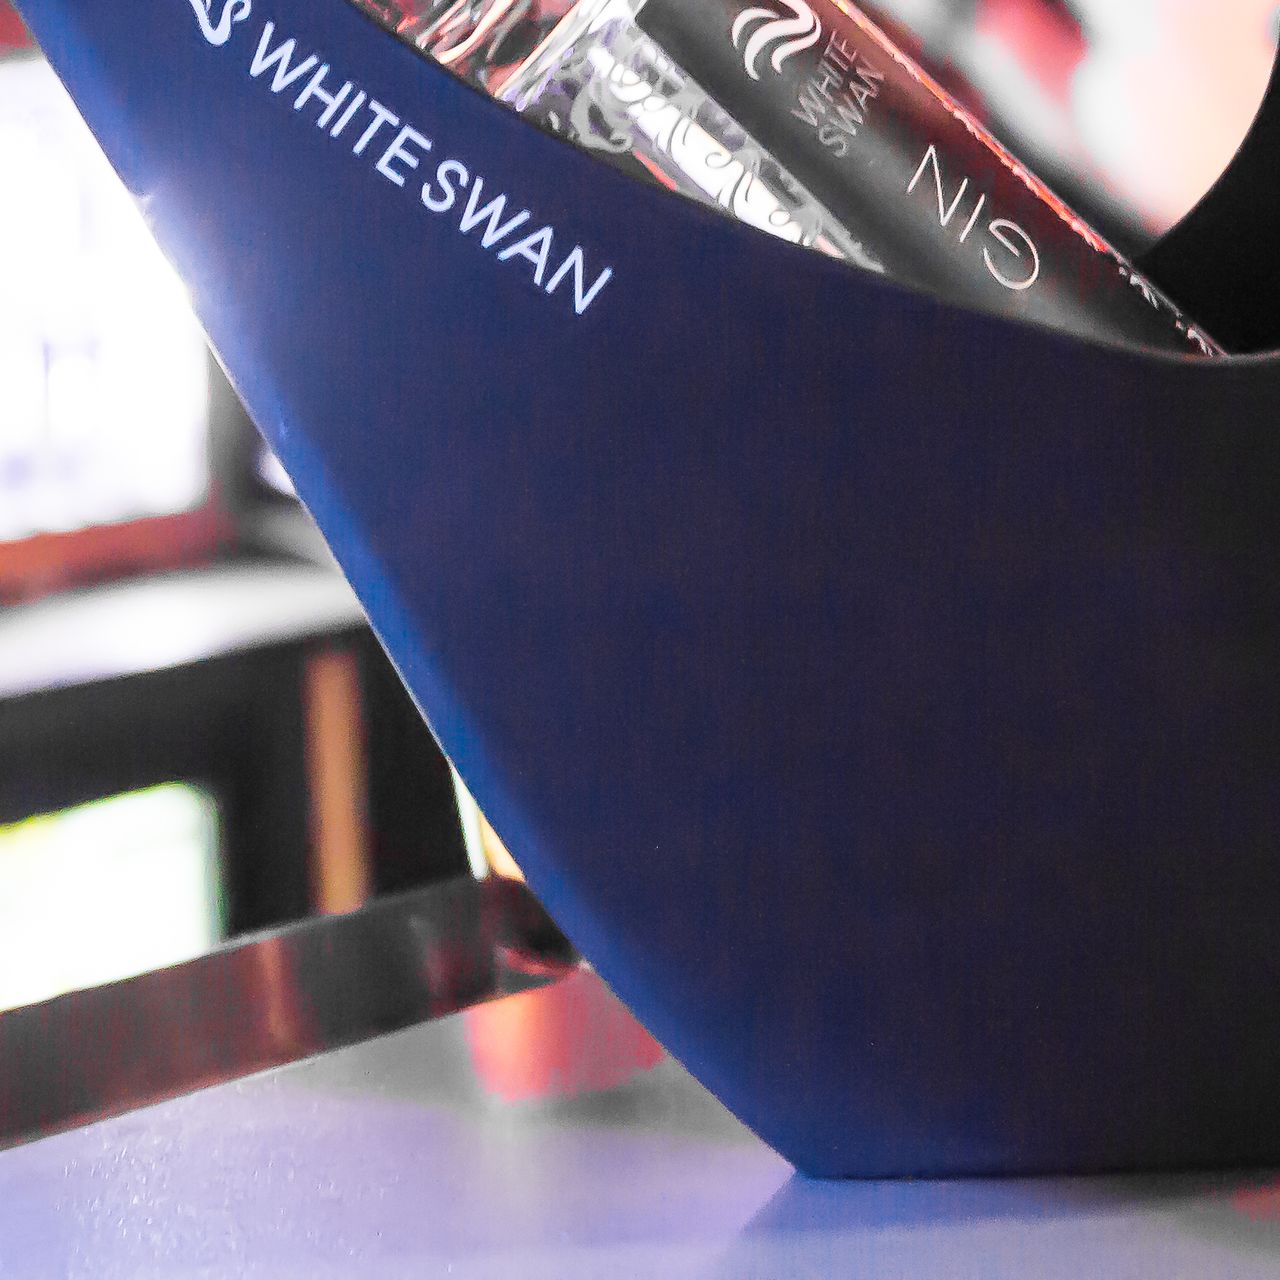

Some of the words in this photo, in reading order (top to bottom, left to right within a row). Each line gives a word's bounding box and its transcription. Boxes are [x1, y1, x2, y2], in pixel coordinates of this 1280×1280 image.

[790, 30, 858, 128] WHITE
[818, 58, 885, 159] SWAN
[249, 19, 433, 188] WHITE
[421, 158, 613, 315] SWAN
[906, 144, 1041, 291] GIN
